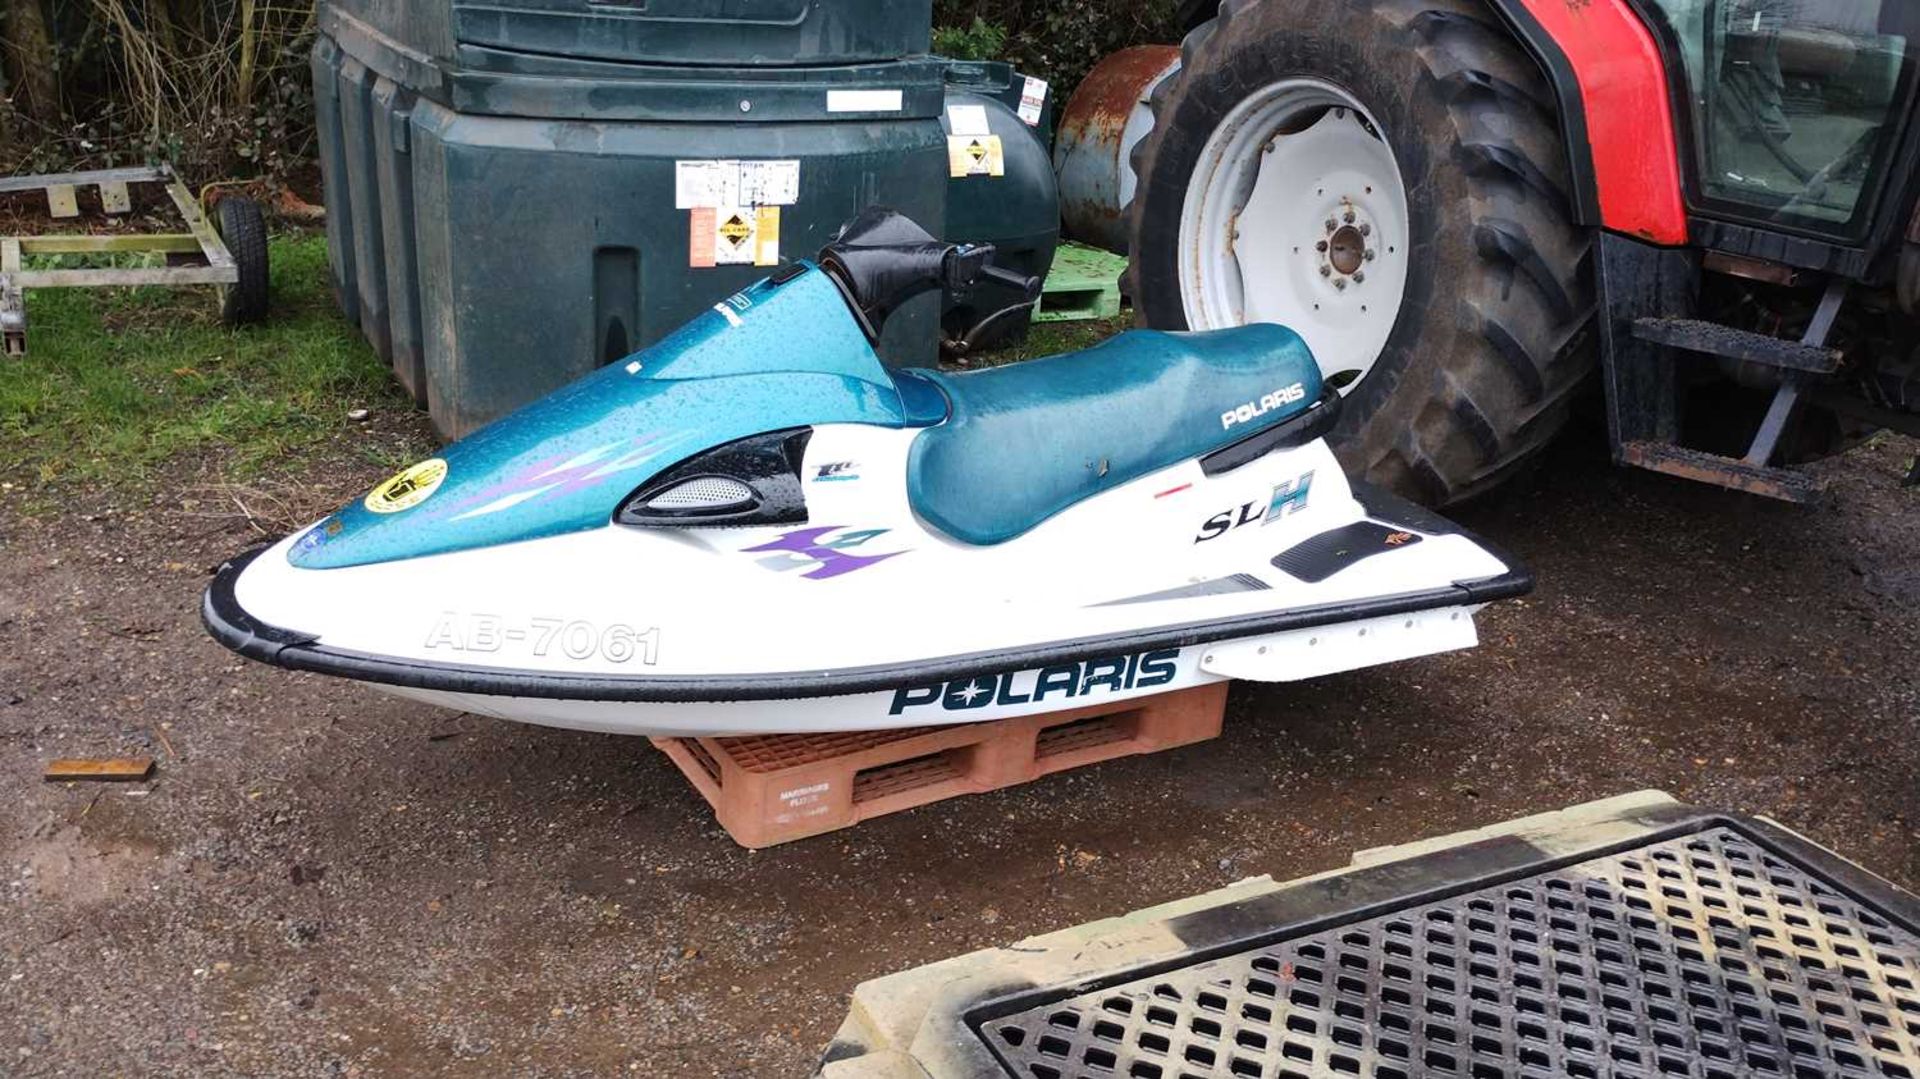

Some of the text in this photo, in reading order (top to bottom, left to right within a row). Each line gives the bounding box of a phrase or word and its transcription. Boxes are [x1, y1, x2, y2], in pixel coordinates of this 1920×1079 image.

[1221, 382, 1305, 430] POLARIS
[1194, 469, 1316, 545] SLH
[424, 610, 661, 666] AB-7061
[889, 648, 1180, 715] POLARIS
